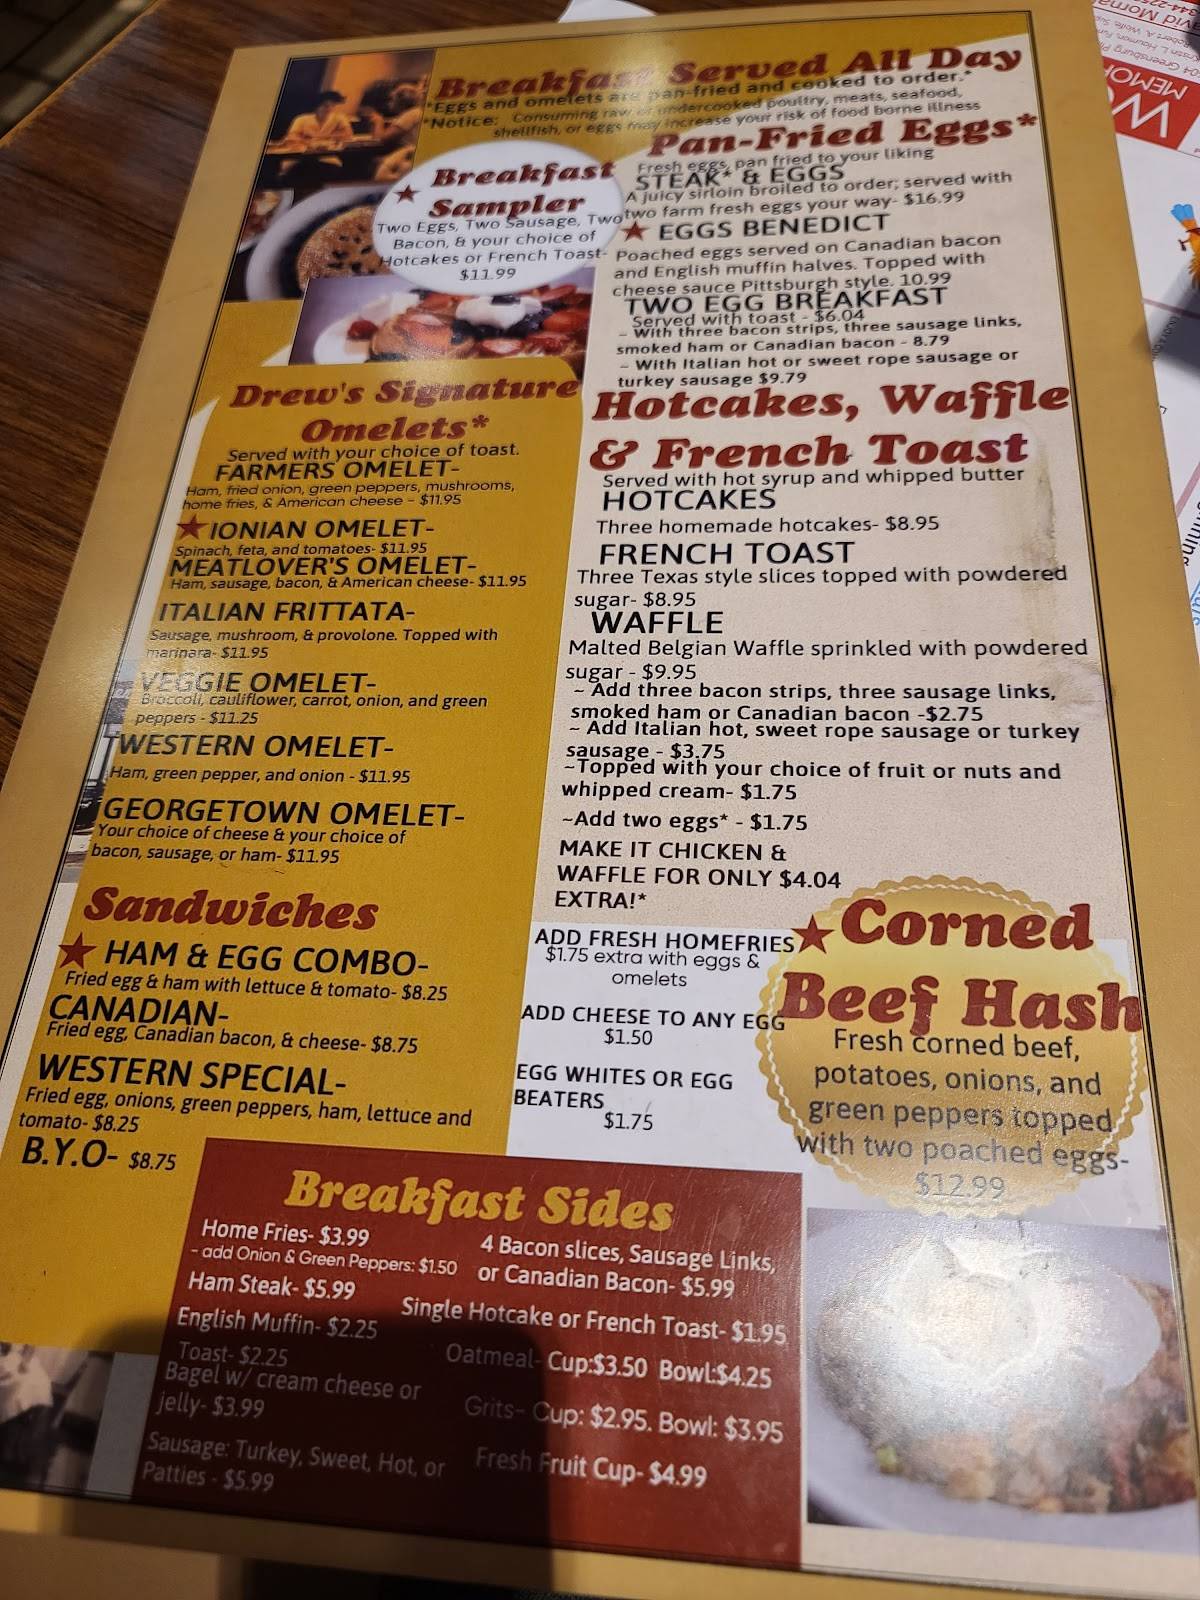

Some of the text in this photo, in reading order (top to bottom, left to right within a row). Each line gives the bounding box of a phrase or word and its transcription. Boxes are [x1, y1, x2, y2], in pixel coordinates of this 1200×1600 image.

[436, 47, 1023, 97] Breakfast Served All Day
[647, 121, 884, 157] Pan-Fried
[638, 148, 934, 173] Fresh eggs, pan fried to your liking
[430, 160, 616, 188] Breakfast
[742, 170, 760, 185] &
[770, 164, 846, 183] EGGS
[428, 194, 585, 219] Sampler
[378, 214, 623, 234] Two Eggs, Two Sausage, Two
[659, 214, 891, 241] EGGS BENEDICT
[617, 233, 1001, 262] Poached eggs served on Canadian bacon
[460, 268, 516, 281] $11.99
[624, 287, 948, 315] TWO EGG BREAKFAST
[229, 377, 583, 409] Drew's Signature
[618, 372, 807, 390] turkey sausage $9.79
[591, 379, 1070, 423] Hotcakes, Waffle
[589, 432, 1029, 471] & French Toast
[215, 458, 460, 482] FARMERS OMELET-
[603, 488, 777, 511] HOTCAKES
[209, 518, 435, 540] IONIAN OMELET-
[596, 515, 940, 534] Three homemade hotcakes- $8.95
[168, 556, 477, 577] MEATLOVER'S OMELET-
[598, 541, 856, 566] FRENCH TOAST
[169, 575, 527, 592] Ham, sausage, bacon, & American cheese- $11.95
[158, 601, 416, 622] ITALIAN FRITTATA-
[591, 610, 724, 635] WAFFLE
[140, 672, 377, 694] VEGGIE OMELET-
[591, 683, 632, 699] Add
[636, 683, 694, 699] three
[698, 683, 764, 700] bacon
[768, 683, 831, 702] strips,
[839, 684, 896, 700] three
[902, 685, 992, 703] sausage
[997, 684, 1057, 702] links,
[116, 734, 394, 759] WESTERN OMELET-
[109, 766, 150, 781] Ham,
[153, 769, 198, 784] green
[201, 770, 261, 785] pepper,
[265, 769, 295, 782] and
[298, 770, 346, 783] onion
[358, 769, 411, 785] $11.95
[101, 797, 466, 827] GEORGETOWN OMELET-
[622, 813, 662, 829] two
[749, 813, 808, 831] $1.75
[559, 840, 787, 862] MAKE IT CHICKEN &
[556, 864, 841, 889] WAFFLE FOR ONLY $4.04
[82, 886, 380, 931] Sandwiches
[841, 899, 1094, 951] Corned
[535, 928, 794, 954] ADD FRESH HOMEFRIES
[105, 939, 430, 977] HAM & EGG COMBO-
[48, 994, 230, 1026] CANADIAN-
[779, 972, 1142, 1036] Beef Hash
[603, 1028, 653, 1047] $1.50
[834, 1029, 1080, 1062] Fresh corned beef,
[37, 1054, 347, 1096] WESTERN SPECIAL-
[516, 1063, 733, 1091] EGG WHITES OR EGG
[513, 1091, 604, 1109] BEATERS
[20, 1136, 178, 1172] B.Y.O- $8.75
[284, 1169, 674, 1232] Breakfast Sides
[202, 1219, 370, 1247] Home Fries- $3.99
[188, 1271, 356, 1300] Ham Steak- $5.99
[401, 1296, 787, 1345] Single Hotcake or French Toast- $1.95
[476, 1447, 707, 1489] Fresh Fruit Cup- $4.99
